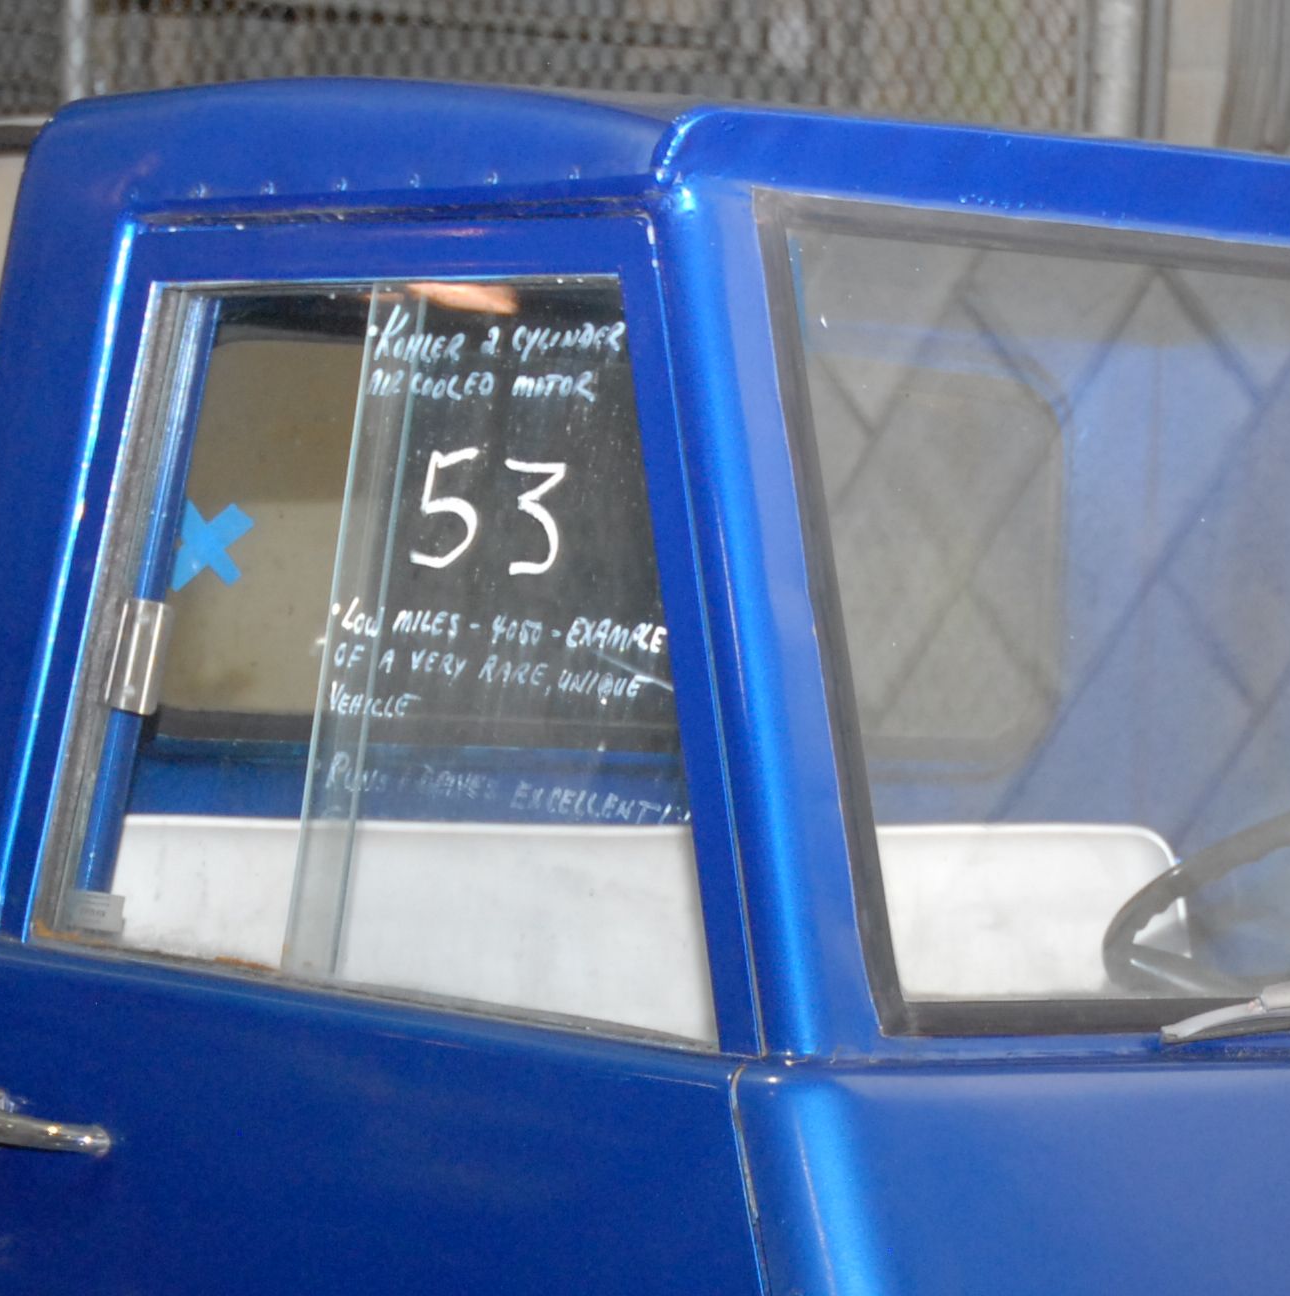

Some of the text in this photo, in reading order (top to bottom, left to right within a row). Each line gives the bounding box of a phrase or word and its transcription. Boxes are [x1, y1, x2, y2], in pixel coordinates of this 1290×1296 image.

[373, 304, 626, 363] KOHLER 2 CYLINDER
[410, 371, 495, 401] COOLED
[512, 370, 596, 402] MOTOR
[410, 447, 567, 576] 53
[341, 597, 385, 637] LOW
[392, 610, 461, 638] MILES
[565, 616, 668, 654] EXAMPLE
[329, 680, 422, 719] VEHICLE
[333, 642, 654, 705] OF A VERY RARE, UNIQUE
